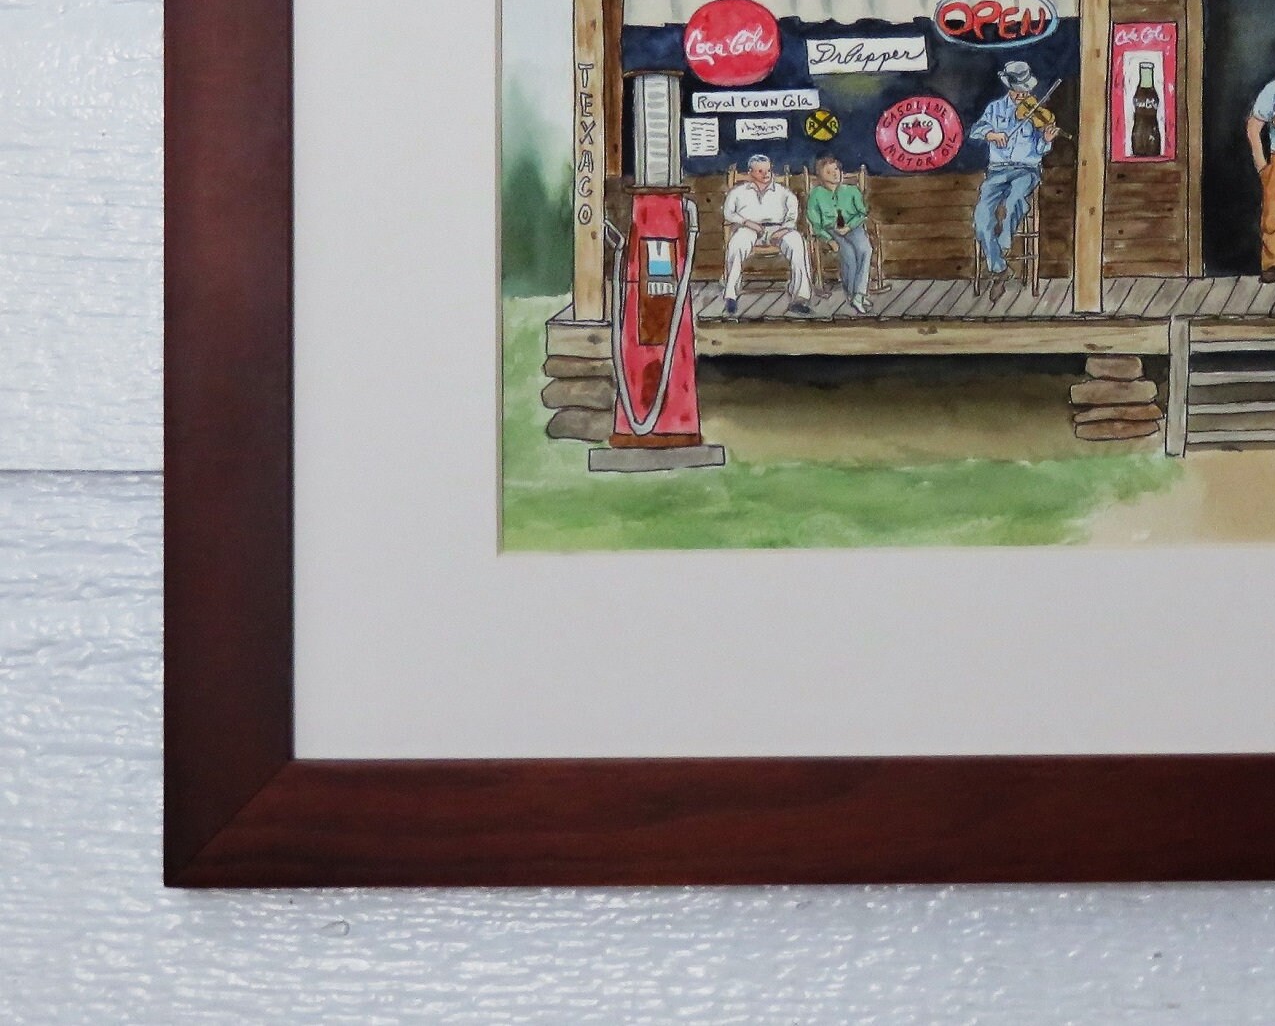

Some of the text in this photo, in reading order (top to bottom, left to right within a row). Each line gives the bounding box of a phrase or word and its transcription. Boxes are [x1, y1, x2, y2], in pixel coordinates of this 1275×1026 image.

[937, 0, 1047, 41] OPEN
[697, 95, 735, 110] Royal
[783, 94, 812, 108] Cola
[882, 100, 947, 129] GASOLINE
[577, 62, 596, 225] TEXACO
[884, 133, 957, 167] MOTOR OIL
